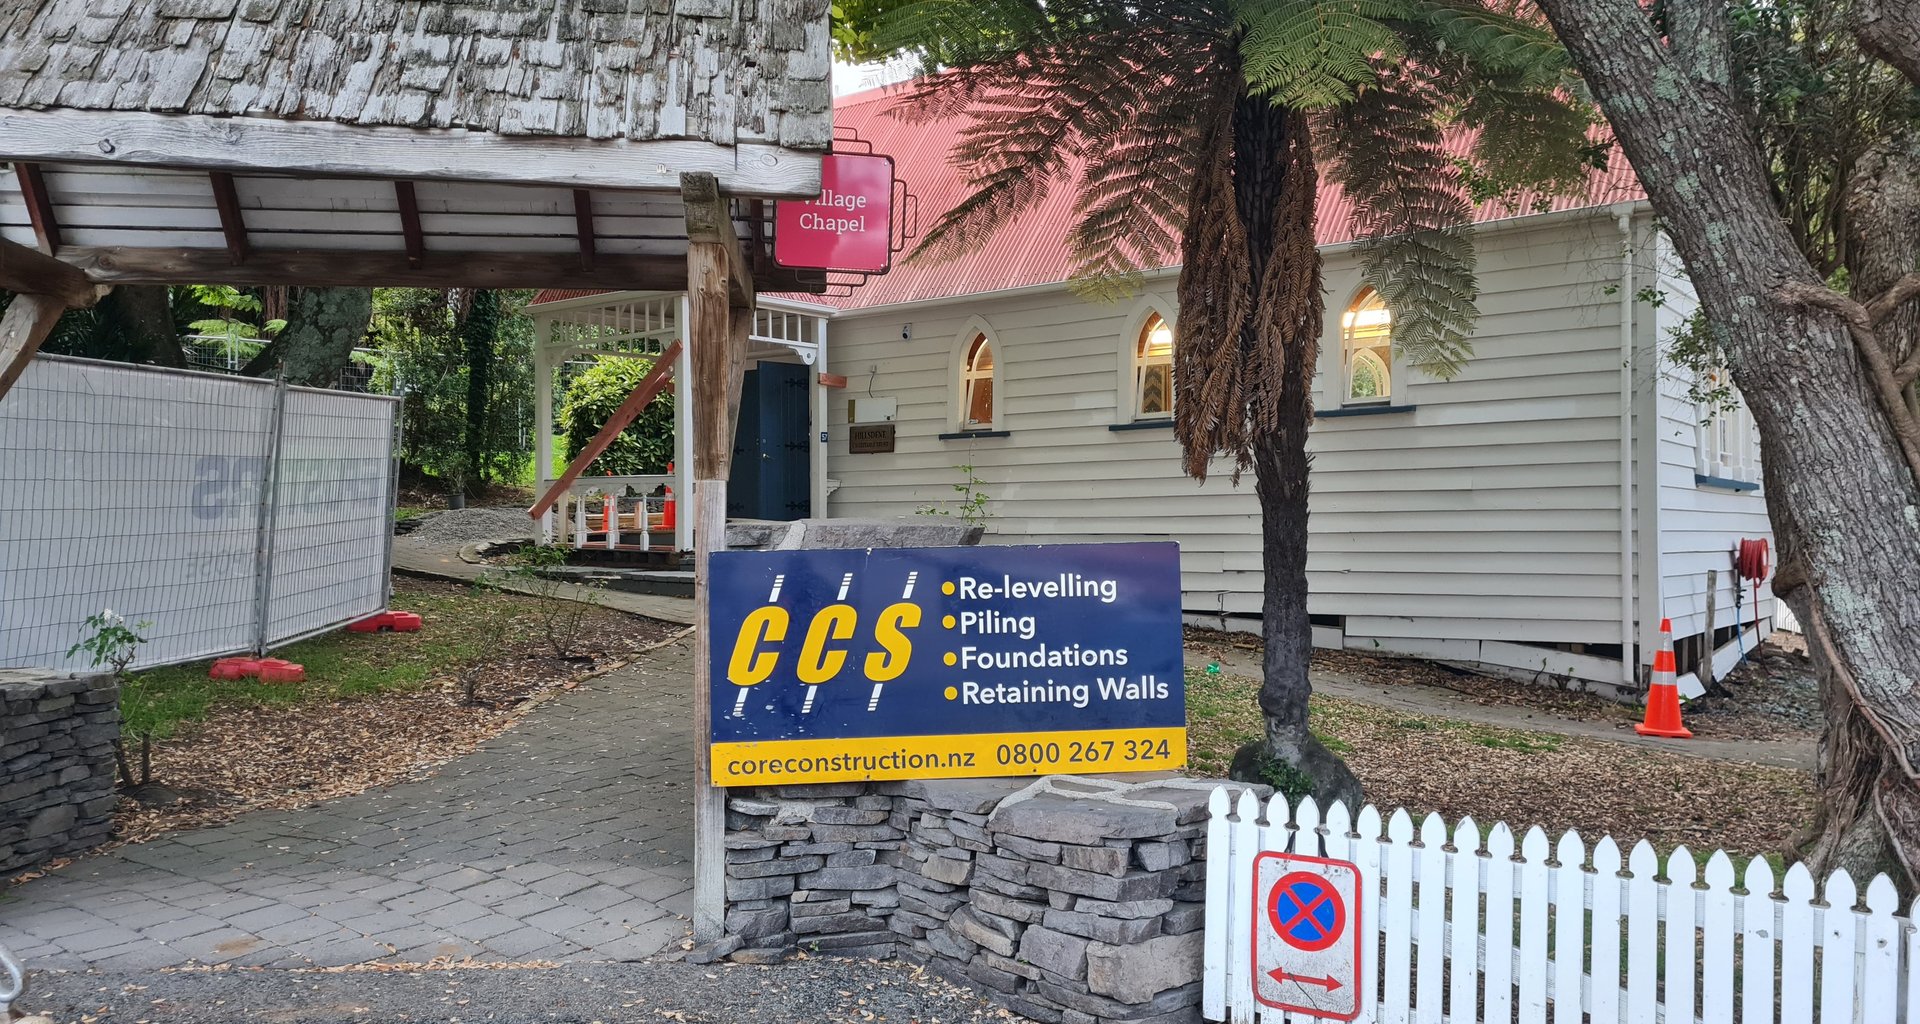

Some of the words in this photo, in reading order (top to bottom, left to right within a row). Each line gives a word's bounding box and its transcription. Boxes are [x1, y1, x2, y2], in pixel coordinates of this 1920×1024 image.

[804, 189, 867, 211] llage
[800, 213, 865, 235] Chapel
[959, 573, 1117, 603] Re-levelling
[960, 610, 1036, 639] Piling
[961, 644, 1128, 670] Foundations
[962, 680, 1089, 708] Retaining
[1096, 676, 1169, 701] Walls
[727, 748, 976, 776] coreconstruction.nz
[996, 742, 1060, 765] 0800
[1069, 741, 1115, 762] 267
[1124, 739, 1171, 761] 324
